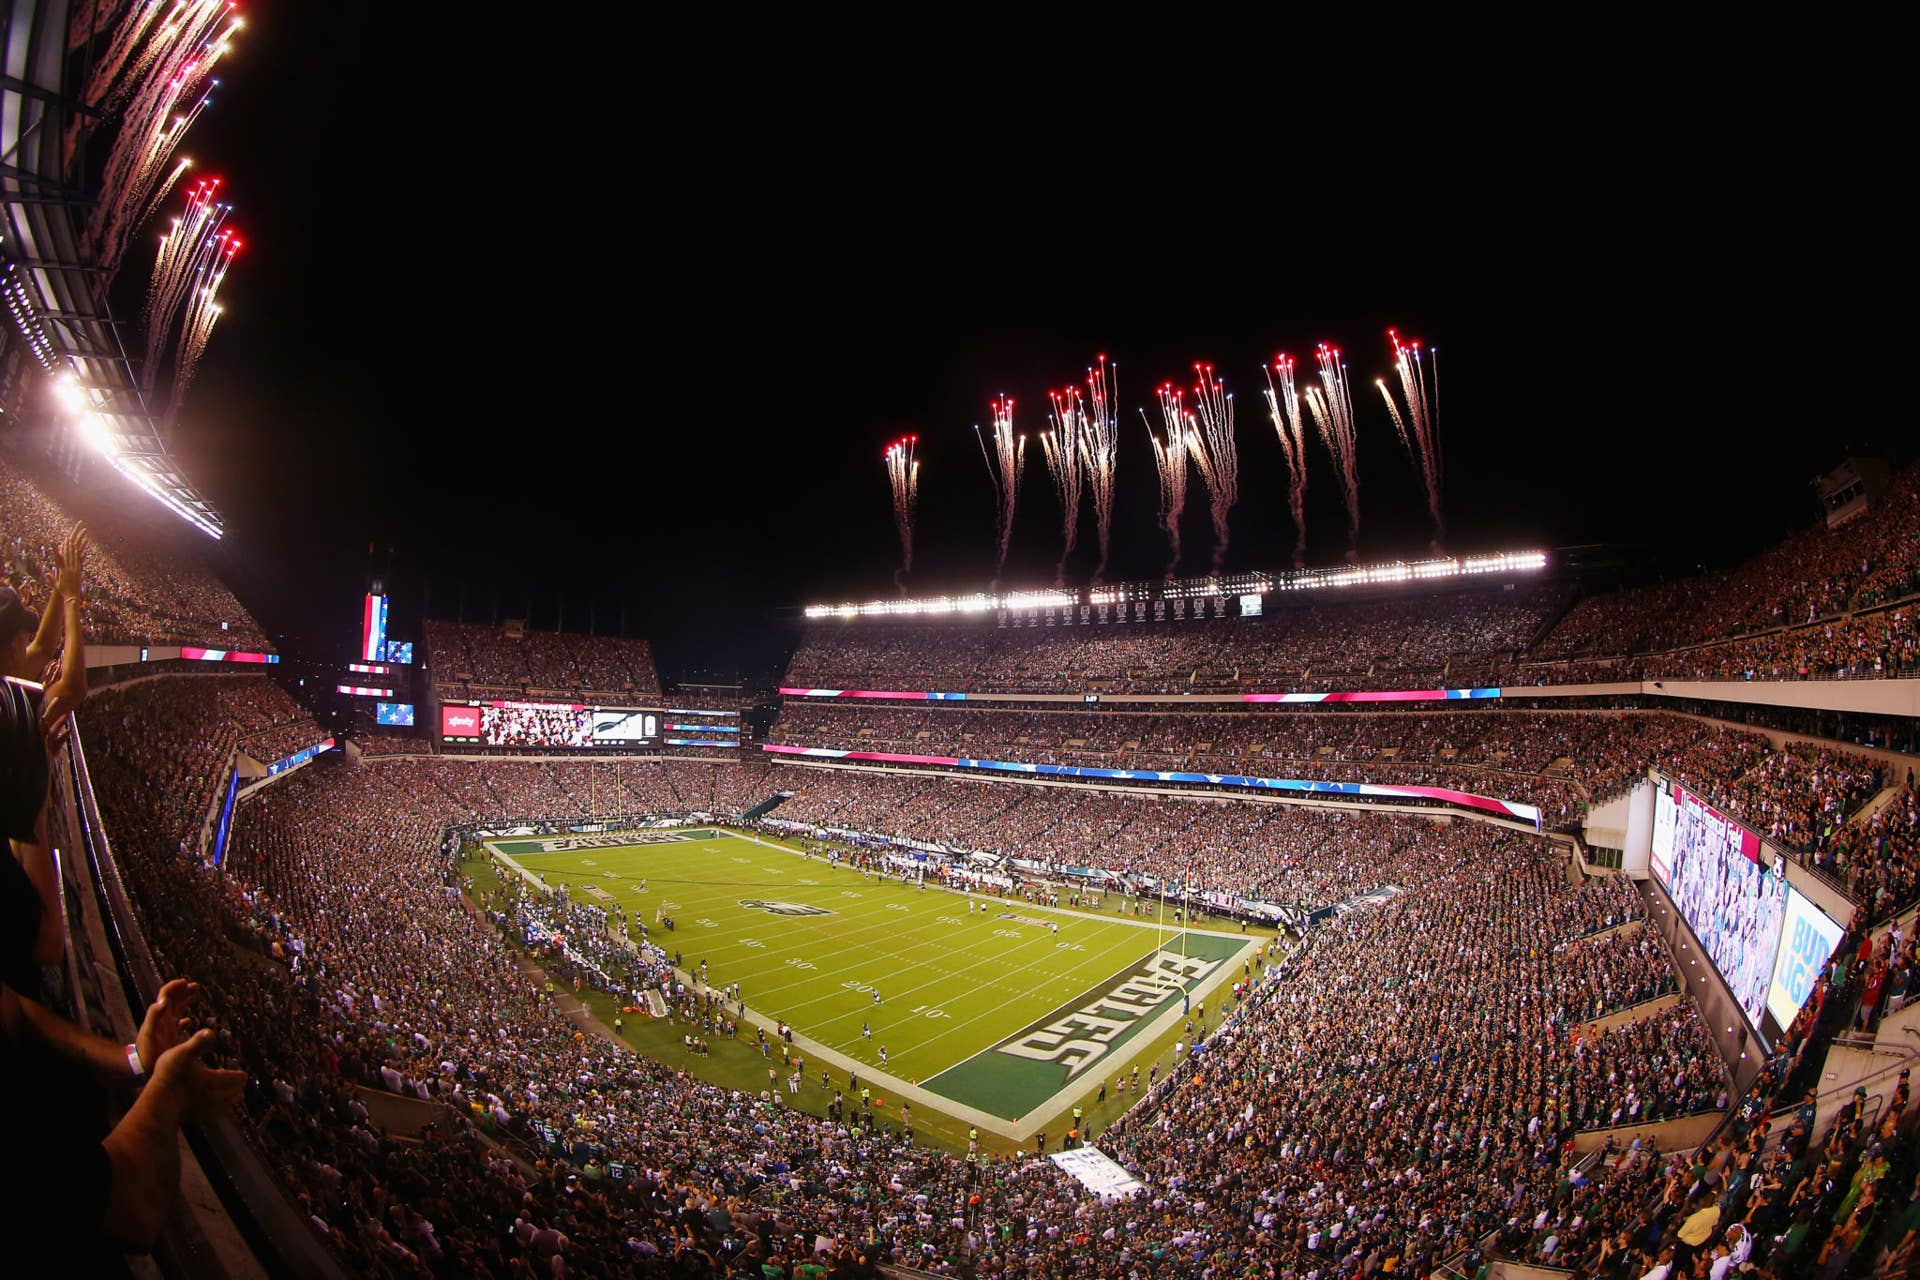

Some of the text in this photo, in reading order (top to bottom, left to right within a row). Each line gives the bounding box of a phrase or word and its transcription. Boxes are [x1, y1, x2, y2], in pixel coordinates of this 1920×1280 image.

[1792, 915, 1830, 976] BUD
[841, 980, 873, 993] 20
[994, 950, 1226, 1082] EAGLES
[611, 1167, 623, 1179] 12
